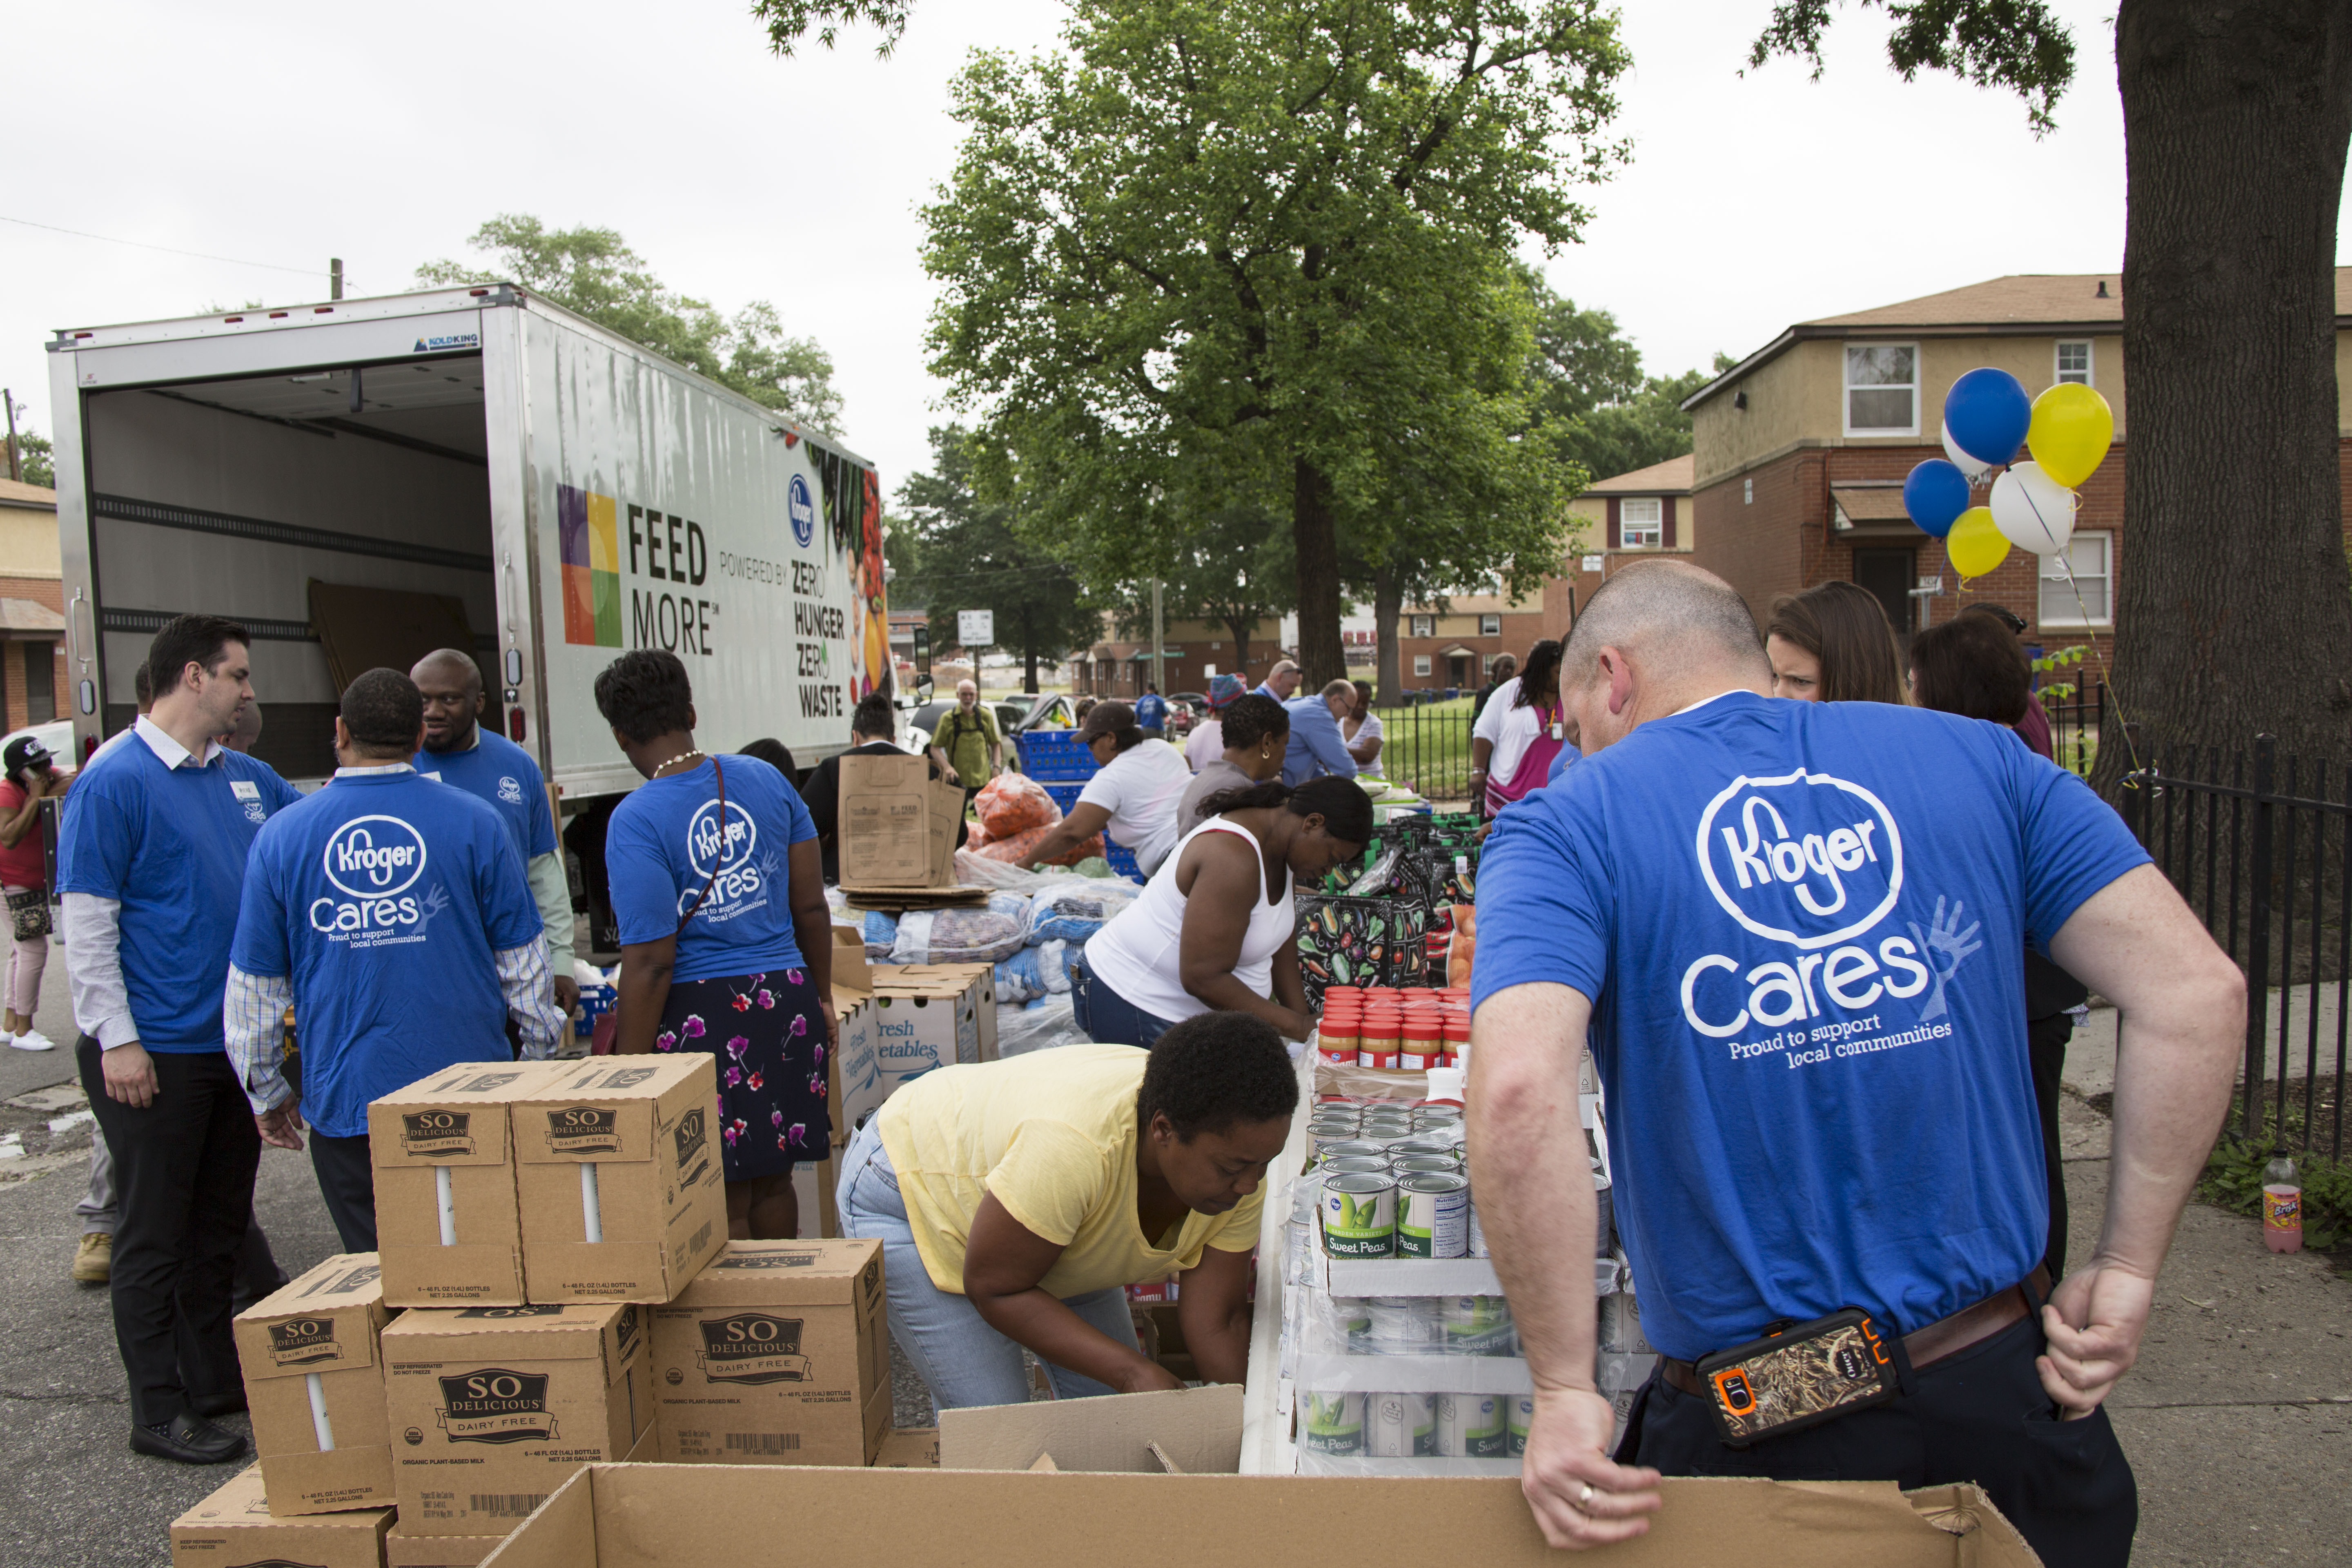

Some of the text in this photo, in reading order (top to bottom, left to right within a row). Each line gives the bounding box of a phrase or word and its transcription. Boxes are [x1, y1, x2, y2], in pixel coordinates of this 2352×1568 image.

[429, 334, 477, 345] KOLDKING
[791, 483, 812, 538] Kroger
[628, 503, 707, 586] FEED
[720, 551, 787, 586] POWERED BY
[791, 559, 825, 599] ZERO
[633, 588, 713, 655] MORE
[794, 601, 845, 640] HUNGER
[797, 642, 830, 680] ZERO
[799, 684, 842, 718] WASTE
[498, 790, 521, 800] Cares
[245, 811, 266, 820] Cares
[337, 829, 416, 886] Kroger
[1721, 796, 1878, 916] Kroger
[310, 897, 419, 932] Cares
[708, 899, 767, 922] local communities
[719, 899, 742, 913] support
[328, 933, 350, 941] Proud
[362, 929, 394, 939] support
[350, 935, 426, 948] local communities
[1680, 935, 1928, 1038] Cares
[878, 1019, 914, 1036] resh
[850, 1026, 866, 1051] Fresh
[1728, 1014, 1881, 1060] Proud to support
[879, 1040, 938, 1060] etables
[1786, 1023, 1952, 1069] local communities
[846, 1045, 875, 1078] Vegetables
[619, 1072, 650, 1084] SO
[420, 1114, 454, 1128] SO
[565, 1111, 599, 1125] SO
[682, 1116, 698, 1144] SO
[679, 1132, 704, 1160] DELICIOUS
[682, 1150, 704, 1178] DAIRY FREE
[1331, 1199, 1340, 1209] Kroger
[2274, 1201, 2297, 1216] Brisk
[1330, 1237, 1385, 1253] Sweet Peas
[1399, 1235, 1418, 1252] Peas
[350, 1270, 381, 1286] SO
[867, 1265, 875, 1283] SO
[484, 1308, 539, 1317] SO
[286, 1321, 318, 1338] SO
[621, 1311, 633, 1332] SO
[726, 1321, 777, 1341] SO
[277, 1335, 330, 1346] DELICIOUS
[712, 1343, 794, 1353] DELICIOUS
[1457, 1337, 1490, 1349] Sweet
[282, 1350, 304, 1359] DAIRY
[716, 1360, 791, 1372] DAIRY FREE
[468, 1376, 521, 1399] SO
[452, 1399, 539, 1411] DELICIOUS
[458, 1417, 537, 1431] DAIRY FREE
[1328, 1439, 1353, 1449] Peas
[1479, 1437, 1503, 1452] Sweet
